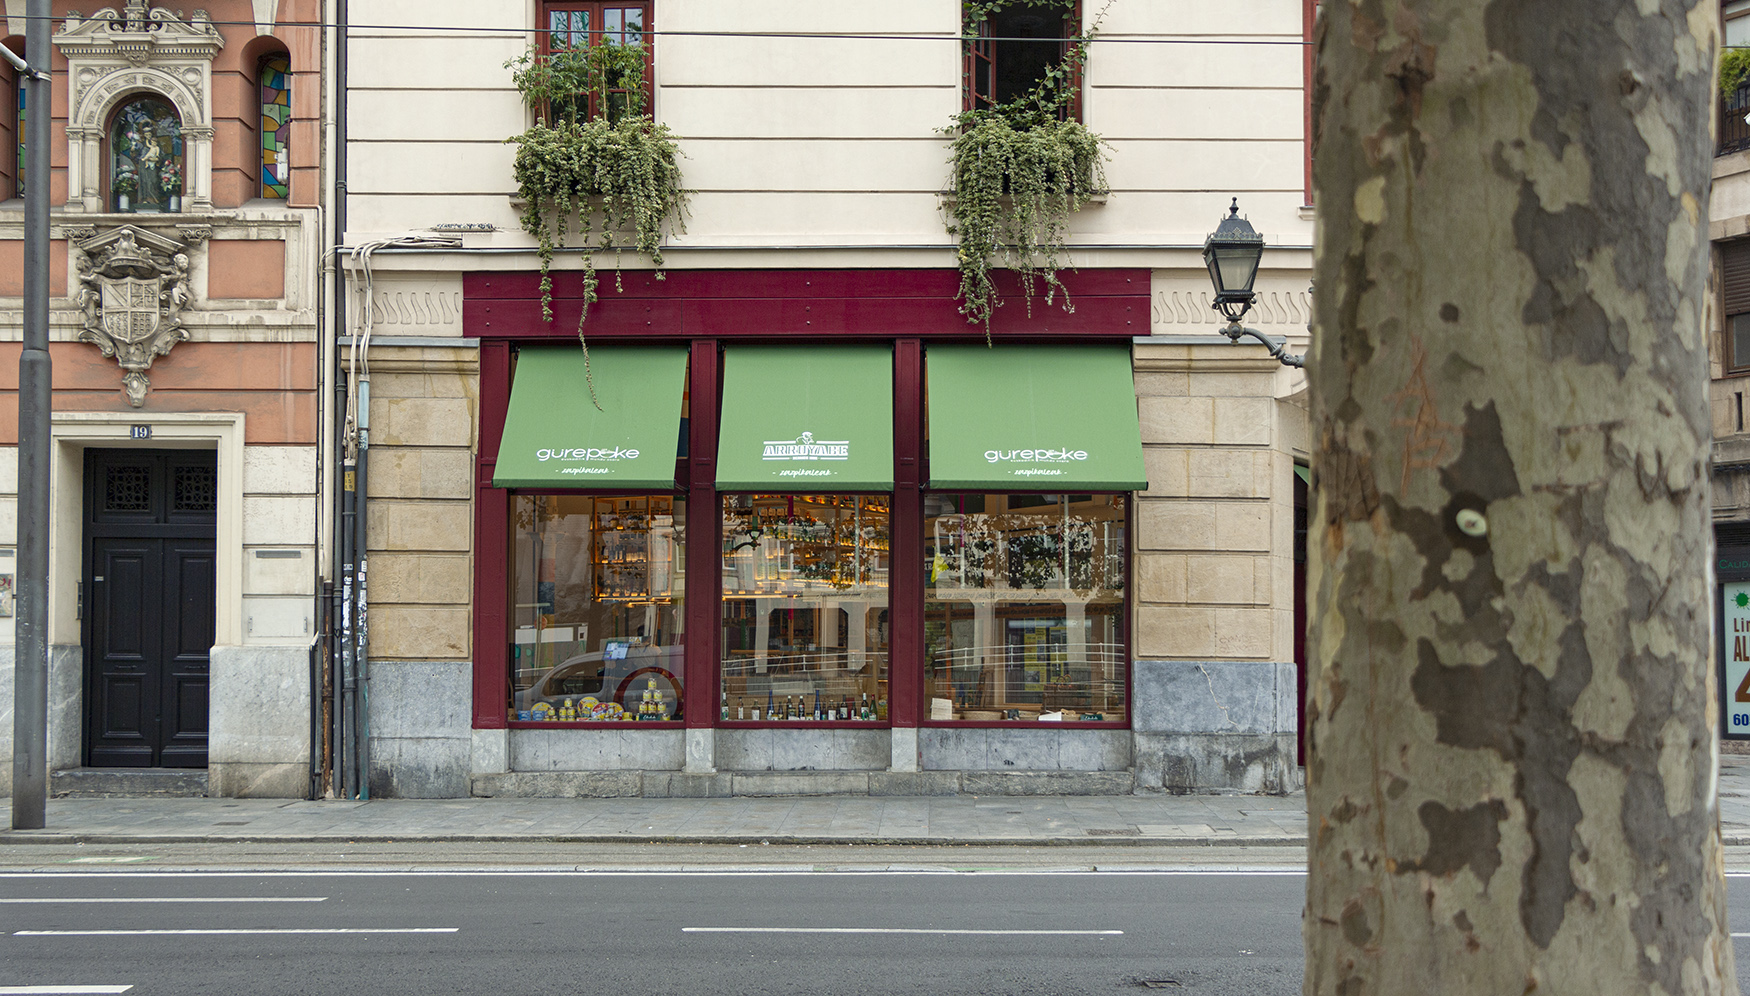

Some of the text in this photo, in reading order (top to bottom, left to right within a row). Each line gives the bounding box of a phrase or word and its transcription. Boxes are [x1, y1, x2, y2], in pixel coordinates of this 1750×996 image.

[133, 426, 148, 438] 19
[536, 446, 640, 461] gurepoke
[762, 445, 849, 457] ARROYABE
[984, 447, 1088, 463] gurepoke
[1719, 559, 1750, 570] CALID
[1733, 713, 1750, 726] 60
